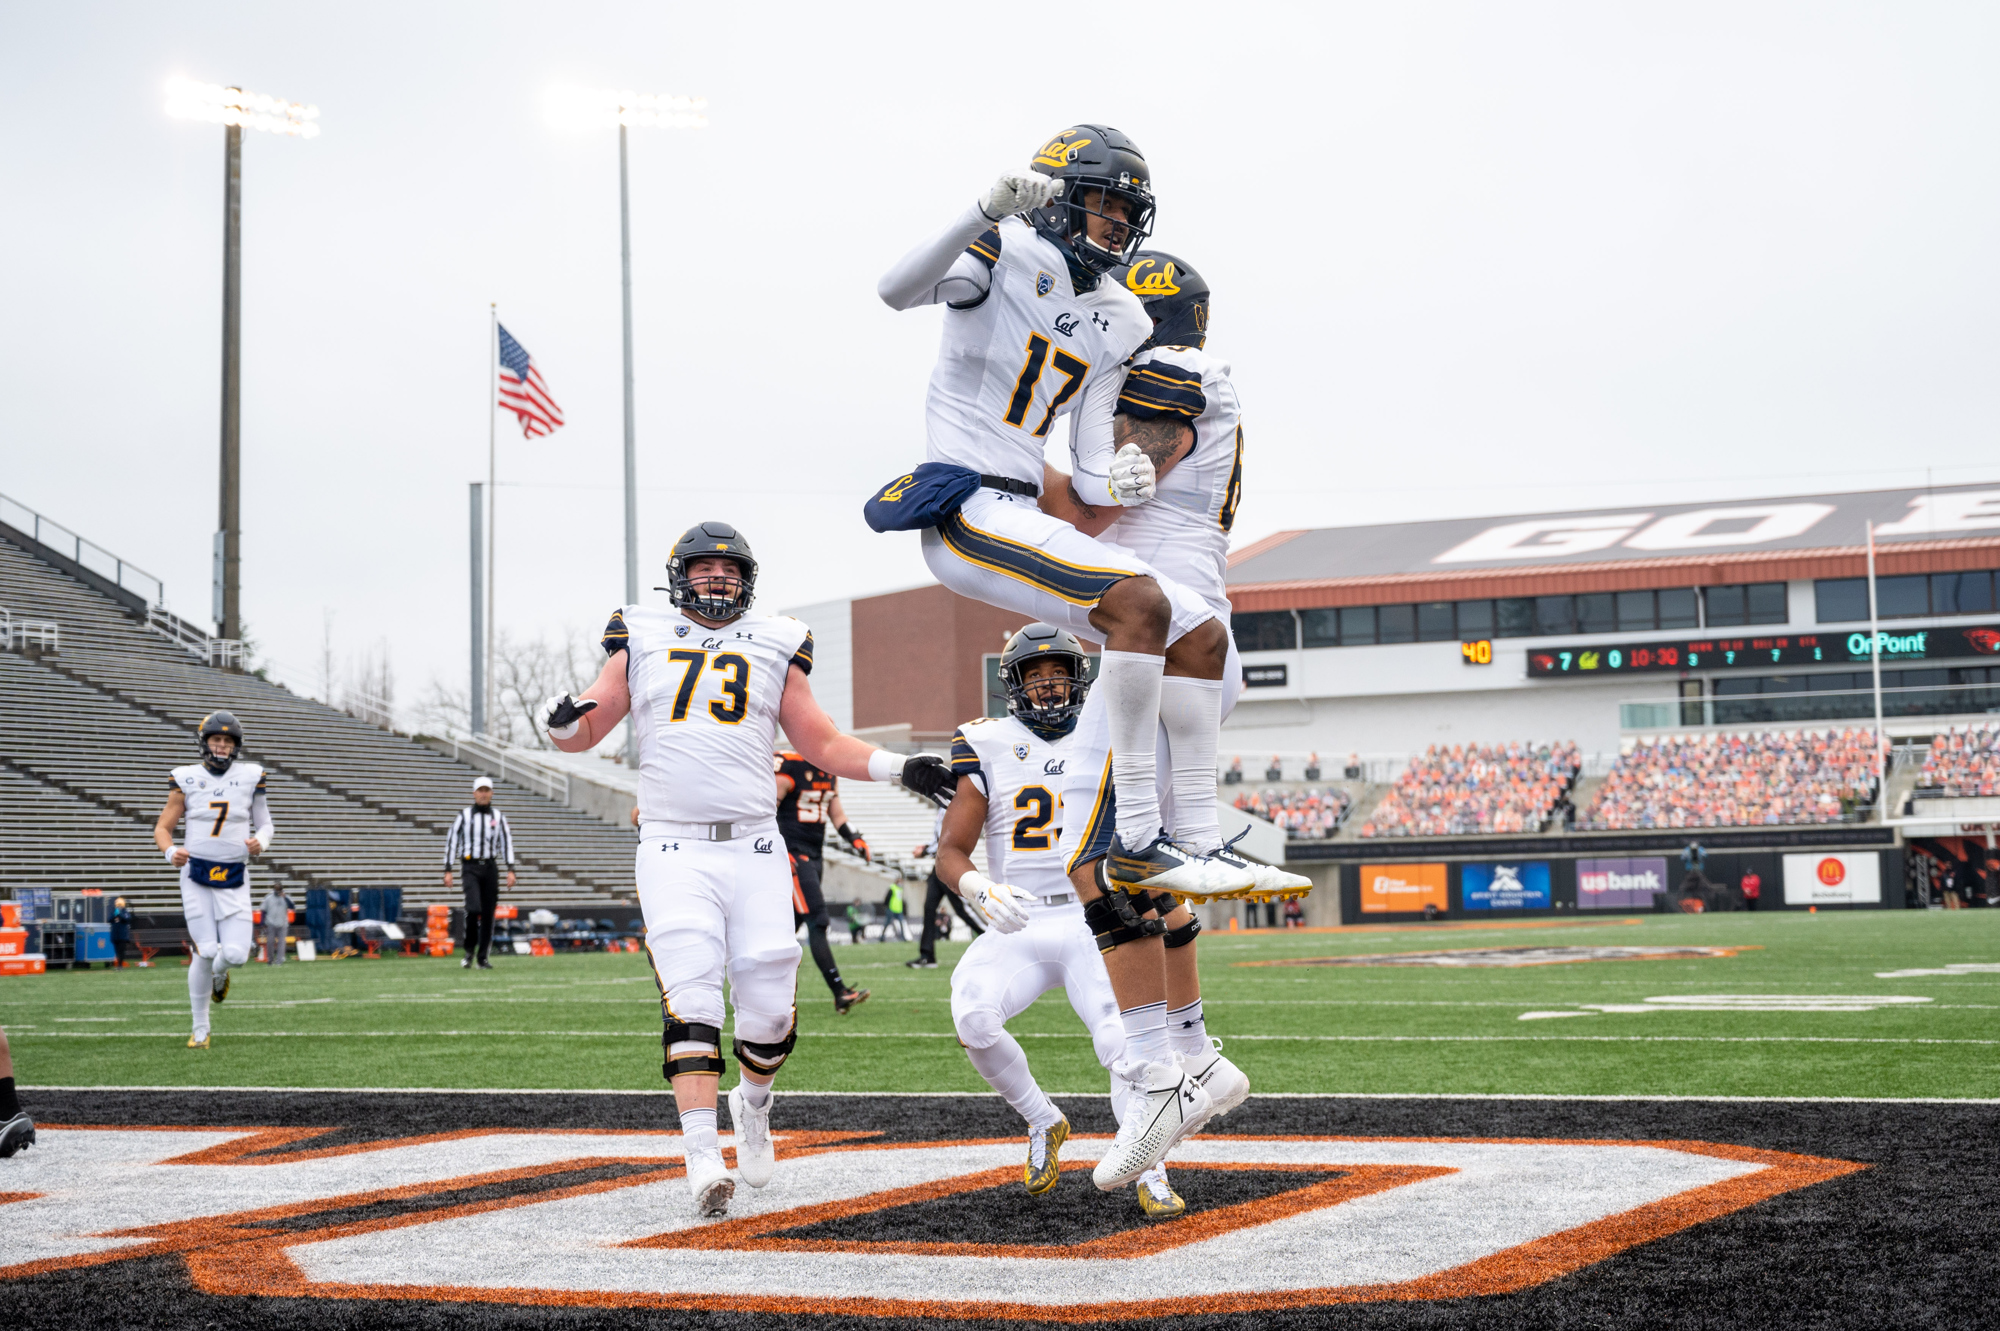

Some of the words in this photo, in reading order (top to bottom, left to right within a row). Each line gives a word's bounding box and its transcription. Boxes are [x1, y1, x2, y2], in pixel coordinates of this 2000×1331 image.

[1032, 130, 1091, 168] Cal
[1126, 259, 1181, 296] Cal
[1053, 313, 1080, 337] Cal
[1002, 330, 1091, 438] 17
[1431, 503, 1838, 564] GO
[701, 637, 724, 650] Cal
[1462, 640, 1492, 664] 40
[1771, 648, 1781, 662] 7
[1814, 646, 1823, 660] 1
[1847, 632, 1928, 655] OnPoint
[1559, 652, 1572, 671] 7
[1608, 649, 1622, 668] 0
[1688, 652, 1698, 667] 3
[1725, 650, 1735, 665] 7
[668, 648, 751, 725] 73
[1044, 759, 1065, 776] Cal
[209, 801, 229, 837] 7
[1011, 784, 1065, 851] 2
[753, 837, 773, 854] Cal
[209, 866, 229, 881] Cal
